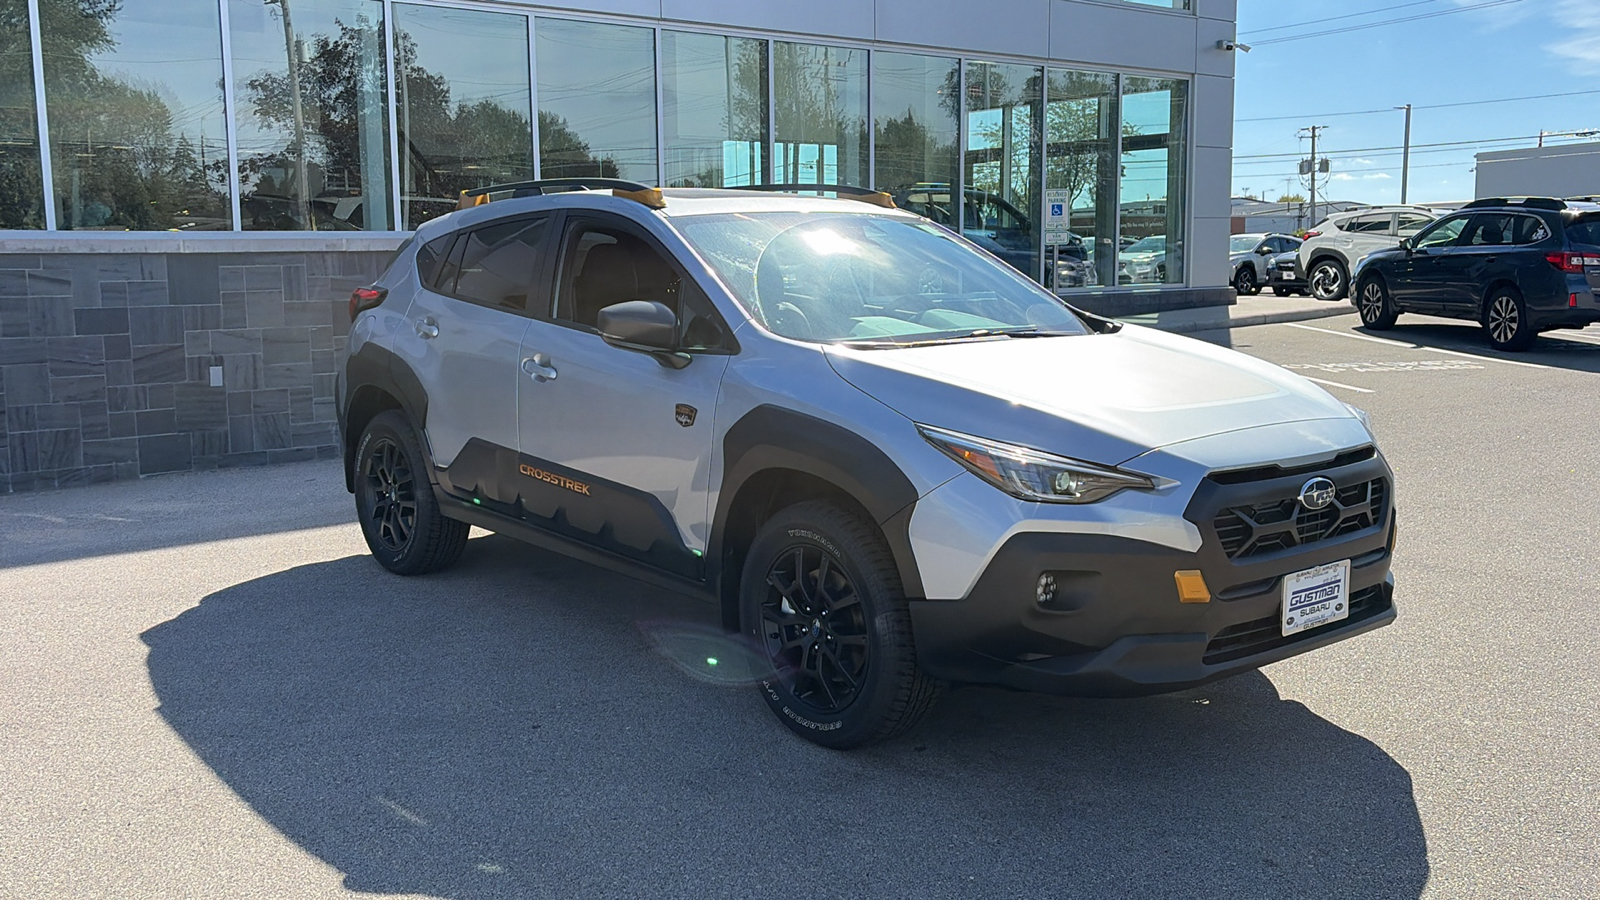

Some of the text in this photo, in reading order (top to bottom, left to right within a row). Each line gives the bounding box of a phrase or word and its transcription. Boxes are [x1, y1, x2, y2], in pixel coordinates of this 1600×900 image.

[519, 464, 591, 496] CROSSTREK
[788, 528, 840, 558] YOKOHAMA
[1300, 602, 1330, 617] SUBARU
[782, 706, 843, 732] GEOLANDAR
